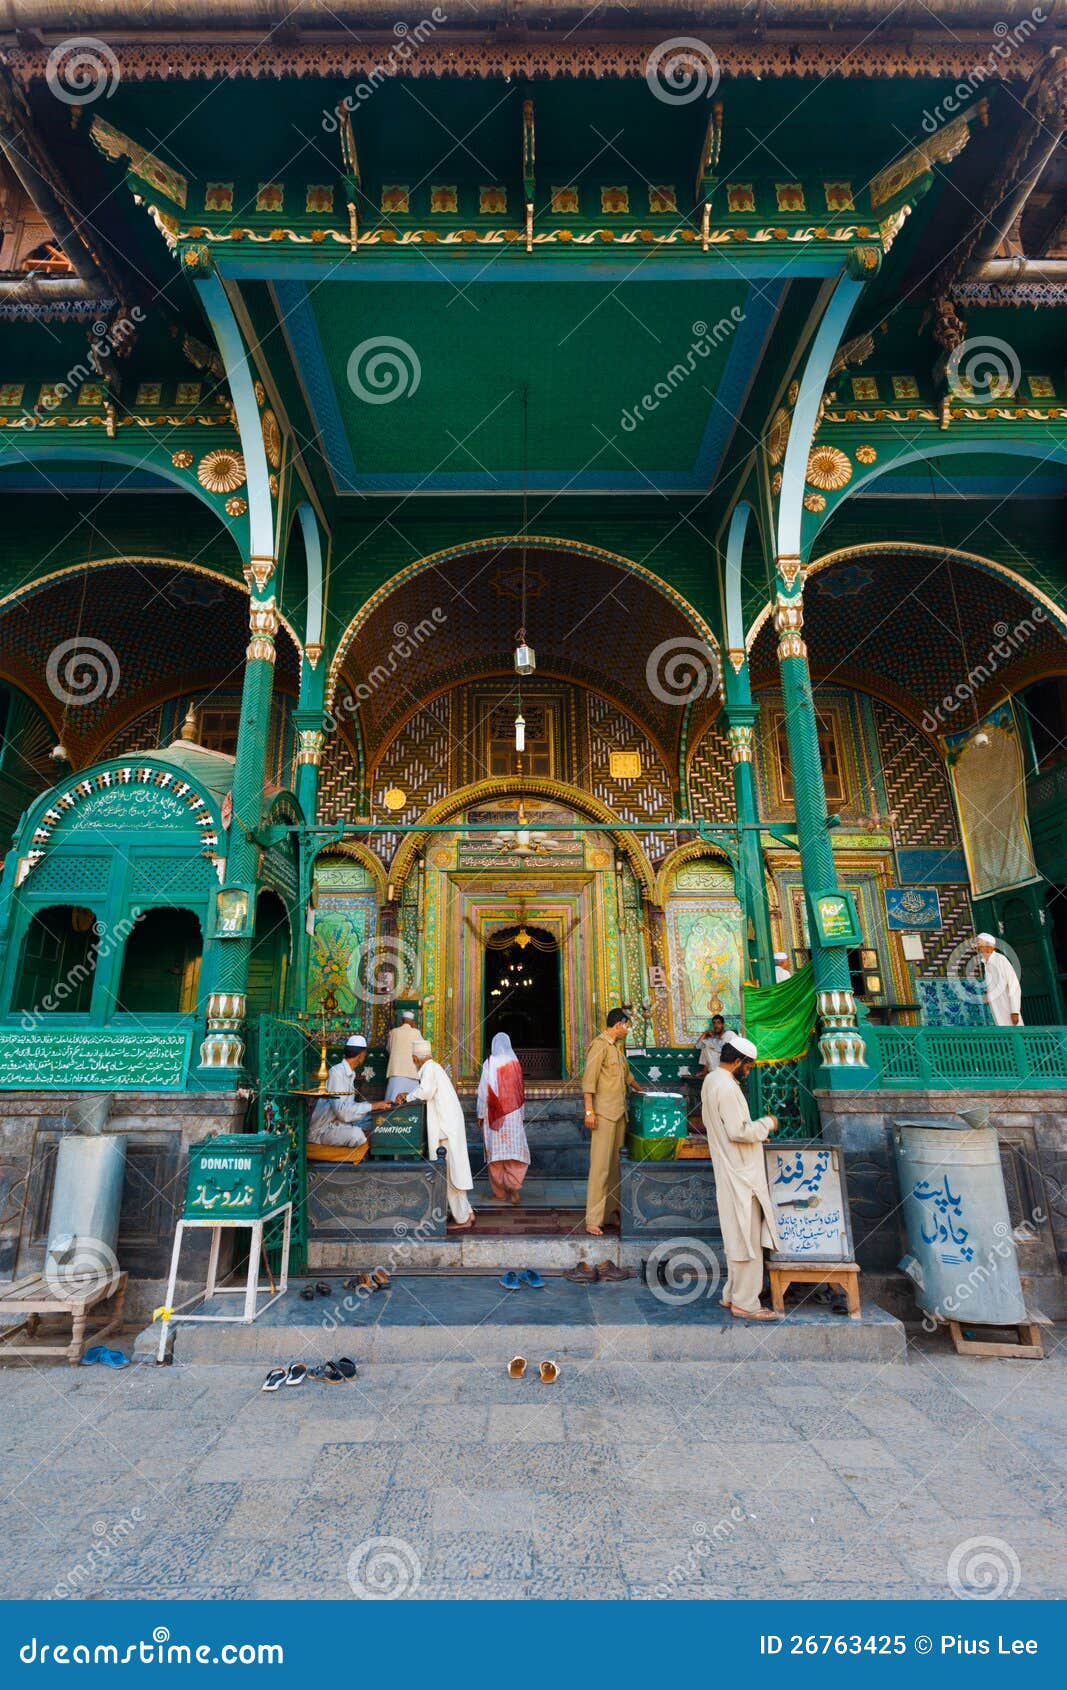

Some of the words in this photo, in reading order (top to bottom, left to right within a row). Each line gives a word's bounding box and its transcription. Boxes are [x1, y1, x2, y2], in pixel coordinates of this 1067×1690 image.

[649, 1112, 667, 1132] فنڈ
[664, 1110, 681, 1137] تعمیر
[200, 1158, 252, 1170] DONATION
[774, 1152, 804, 1184] فنڈ
[794, 1152, 830, 1192] تعمیر
[827, 1228, 839, 1239] اس
[920, 1212, 974, 1262] چاول
